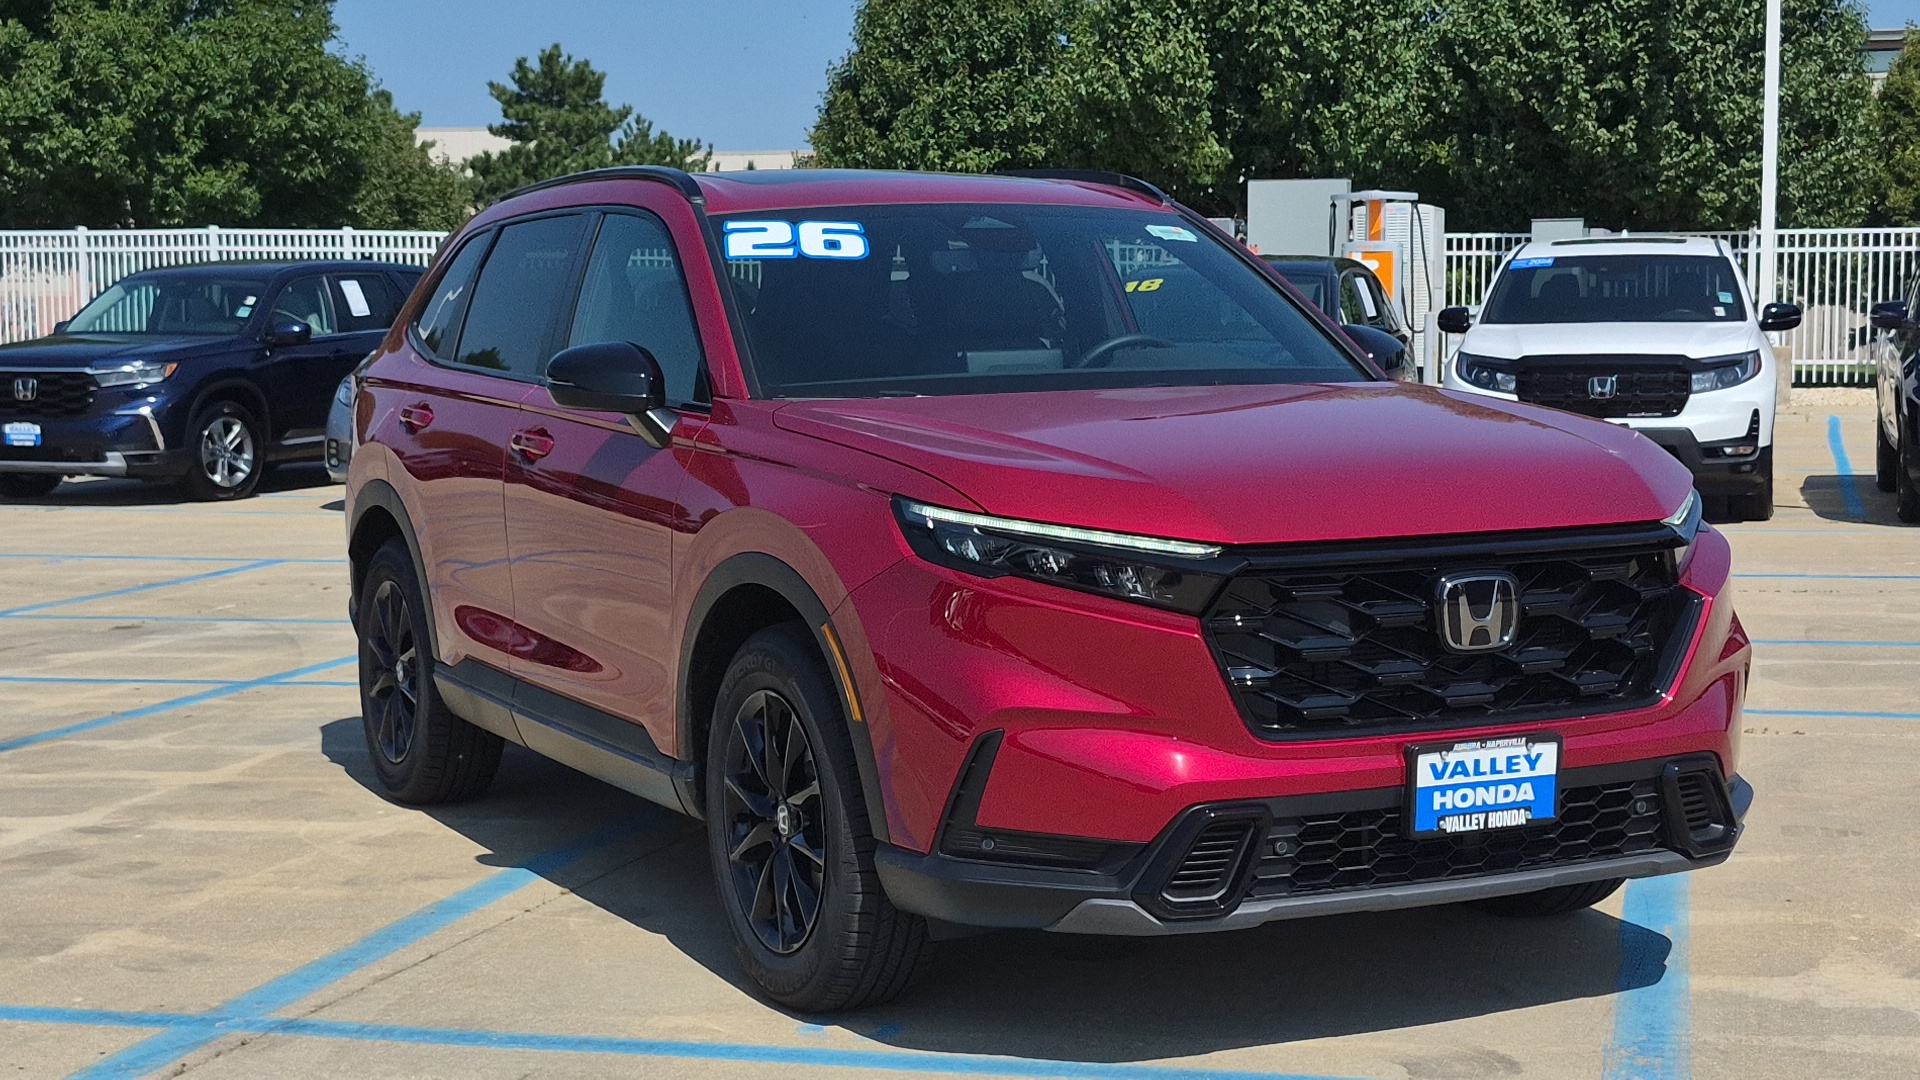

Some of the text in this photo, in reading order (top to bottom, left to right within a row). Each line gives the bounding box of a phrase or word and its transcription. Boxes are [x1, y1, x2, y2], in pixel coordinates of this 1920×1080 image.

[723, 219, 870, 260] 26
[1125, 279, 1164, 292] 18
[1429, 753, 1544, 780] VALLEY
[1433, 782, 1535, 811] HONDA
[1445, 809, 1527, 833] VALLEY HONDA
